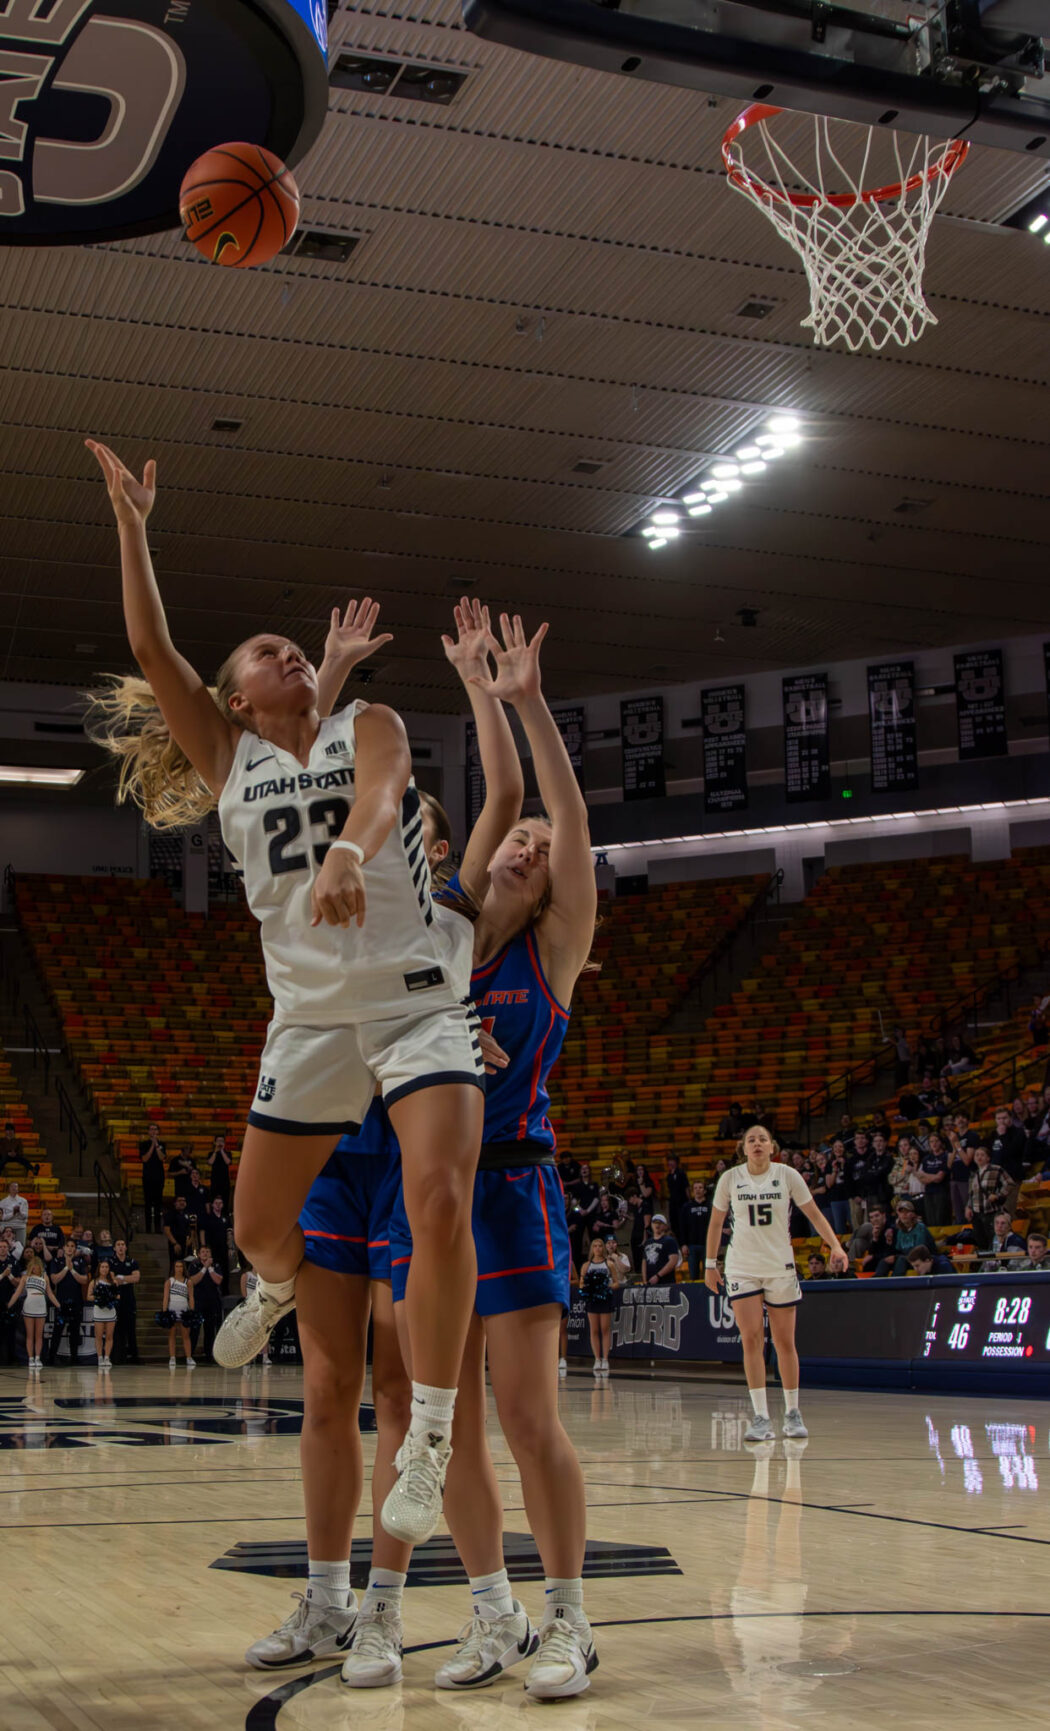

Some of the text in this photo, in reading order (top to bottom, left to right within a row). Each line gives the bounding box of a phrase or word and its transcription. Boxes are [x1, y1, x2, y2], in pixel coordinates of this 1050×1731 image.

[243, 768, 356, 802] UTAH STAT
[192, 834, 203, 847] G
[263, 798, 350, 876] 23
[737, 1191, 782, 1202] UTAH STATE
[748, 1203, 772, 1227] 15
[993, 1296, 1032, 1325] 8:28
[948, 1323, 970, 1350] 46
[988, 1331, 1014, 1343] PERIOD
[923, 1342, 932, 1357] 3
[982, 1346, 1025, 1358] POSSESSION
